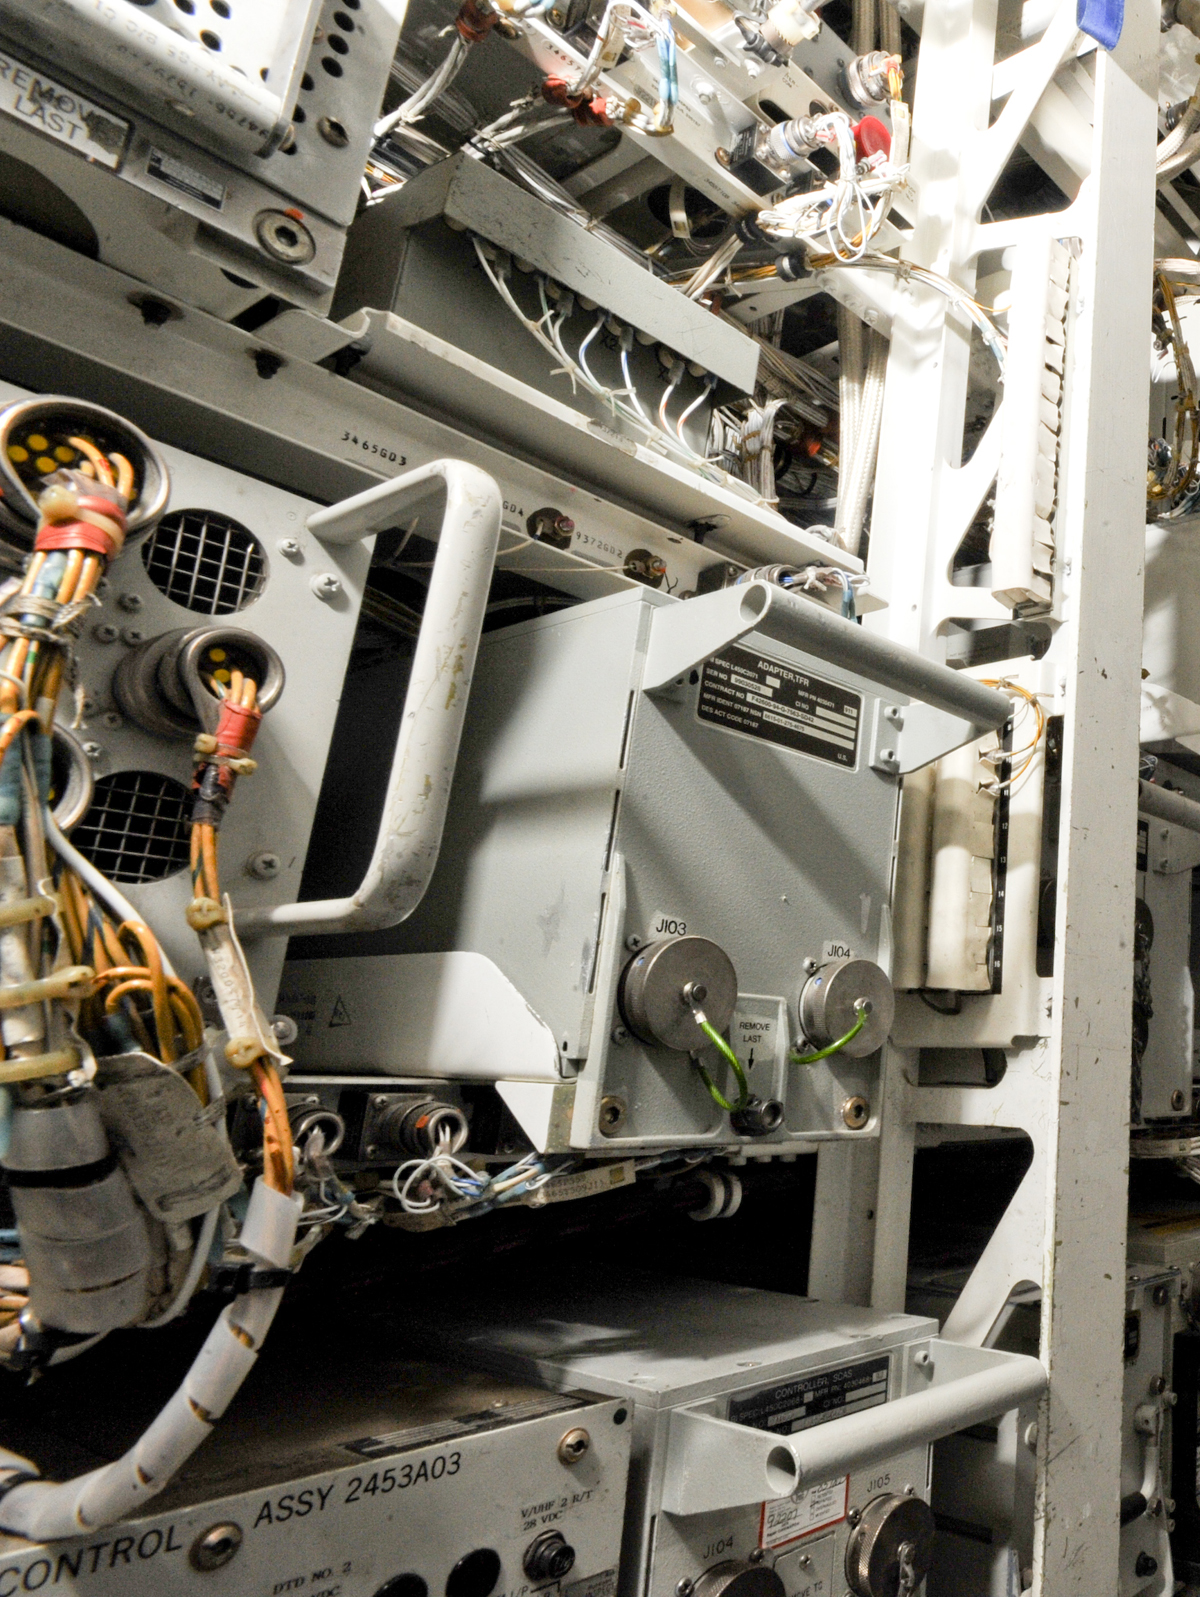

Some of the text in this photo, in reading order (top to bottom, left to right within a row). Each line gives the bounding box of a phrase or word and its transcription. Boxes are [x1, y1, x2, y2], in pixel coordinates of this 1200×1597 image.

[13, 92, 83, 142] LAST
[704, 680, 736, 696] CONTRACT
[736, 691, 745, 699] NO
[738, 1021, 771, 1032] REMOVE
[743, 1034, 762, 1043] LAST
[253, 1451, 462, 1529] ASSY 2453A03
[520, 1489, 595, 1519] V/UHF 2 R/T
[522, 1510, 564, 1532] 28 VDC
[0, 1522, 183, 1597] CONTROL
[342, 1560, 352, 1574] 2
